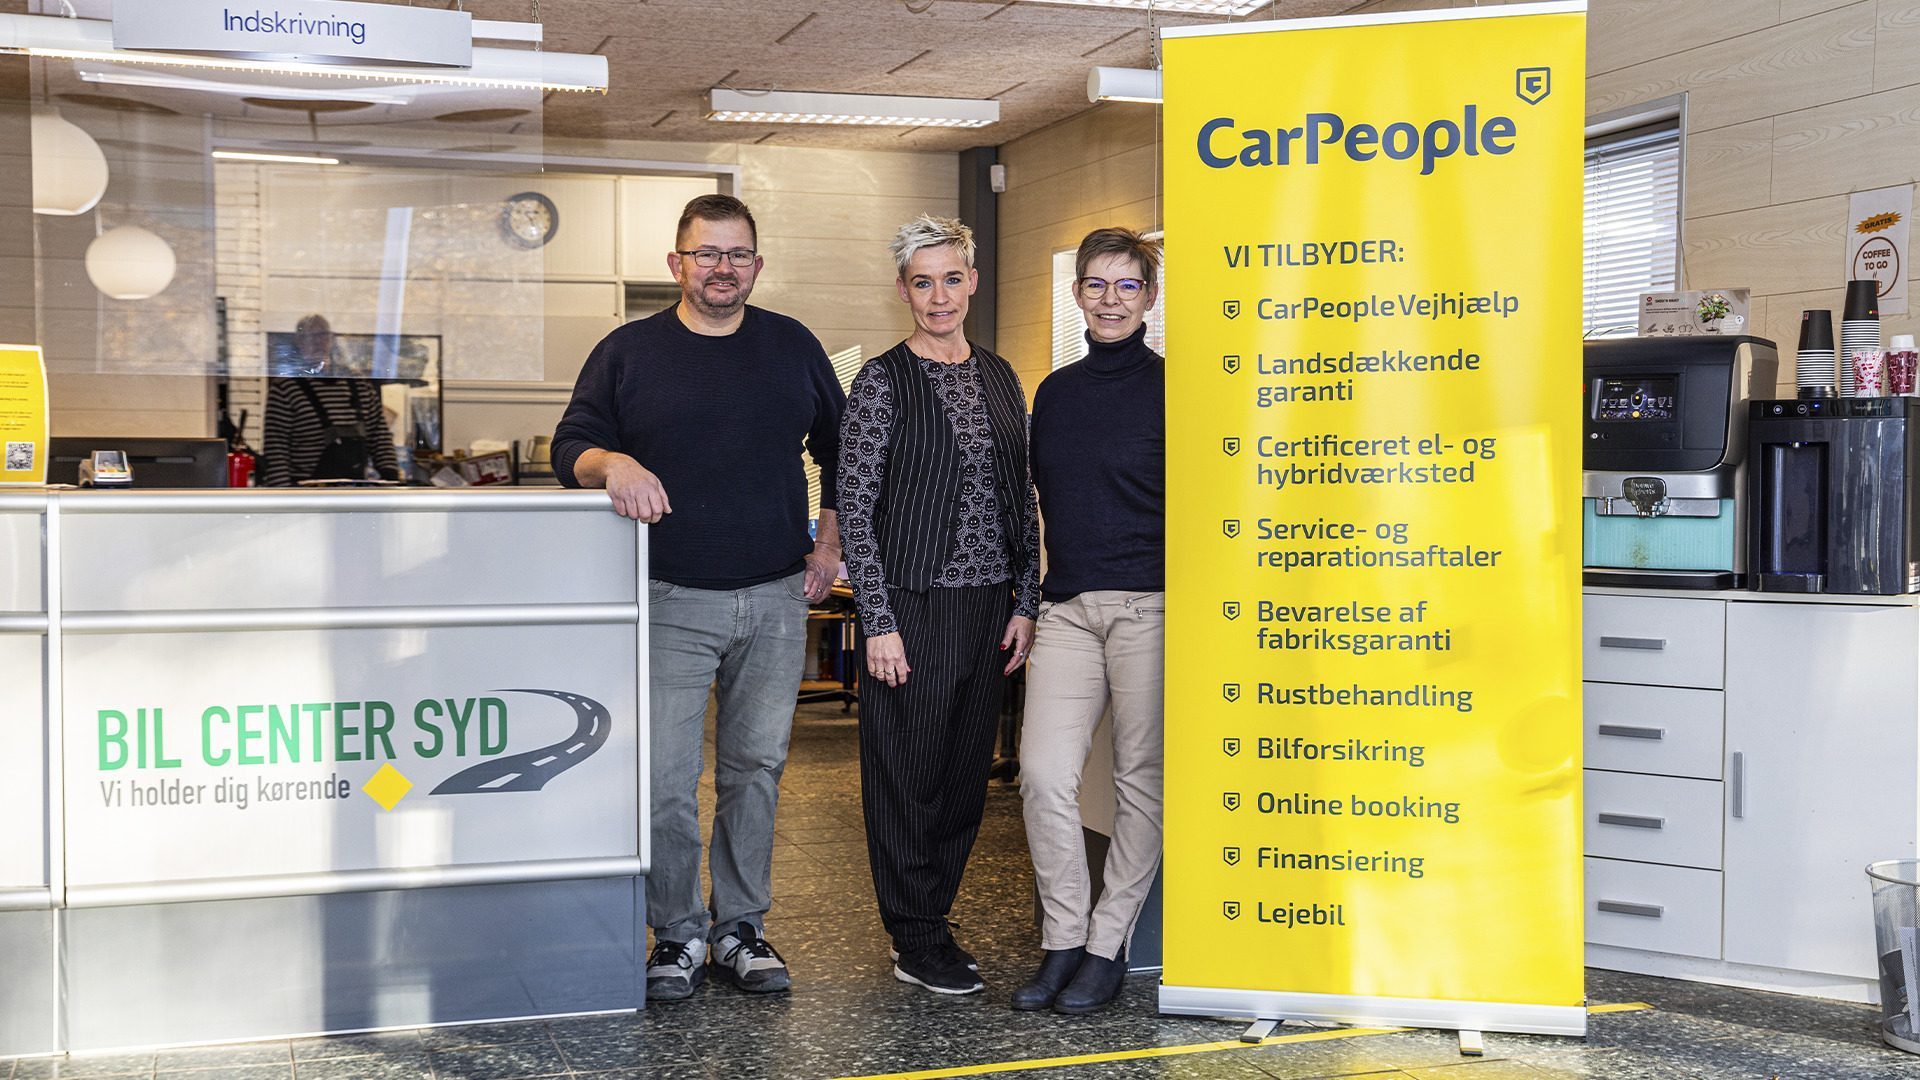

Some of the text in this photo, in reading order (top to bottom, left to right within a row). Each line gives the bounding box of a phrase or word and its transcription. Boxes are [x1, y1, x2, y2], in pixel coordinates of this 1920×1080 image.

[224, 8, 366, 44] Indskrivning
[1197, 105, 1516, 175] CarPeople
[1864, 216, 1892, 229] GRATIS
[1224, 240, 1404, 268] VI TILBYDER:
[1862, 248, 1890, 259] COFFEE
[1865, 260, 1888, 270] TO GO
[1258, 291, 1519, 323] CarPeople Vejhjælp
[1258, 349, 1480, 375] Landsdækkende
[1257, 379, 1353, 408] garanti
[1258, 434, 1497, 460] Certificeret el- og
[1258, 461, 1475, 491] hybridværksted
[1257, 518, 1409, 545] Service- og
[1257, 543, 1502, 573] reparationsaftaler
[1258, 600, 1428, 623] Bevarelse af
[1257, 628, 1451, 656] fabriksgaranti
[1258, 683, 1473, 713] Rustbehandling
[98, 698, 508, 770] BIL CENTER SYD
[1258, 738, 1425, 767] Bilforsikring
[100, 772, 351, 811] Vi holder dig kørende
[1258, 792, 1461, 824] Online booking
[1258, 847, 1425, 879] Finansiering
[1258, 902, 1346, 929] Lejebil
